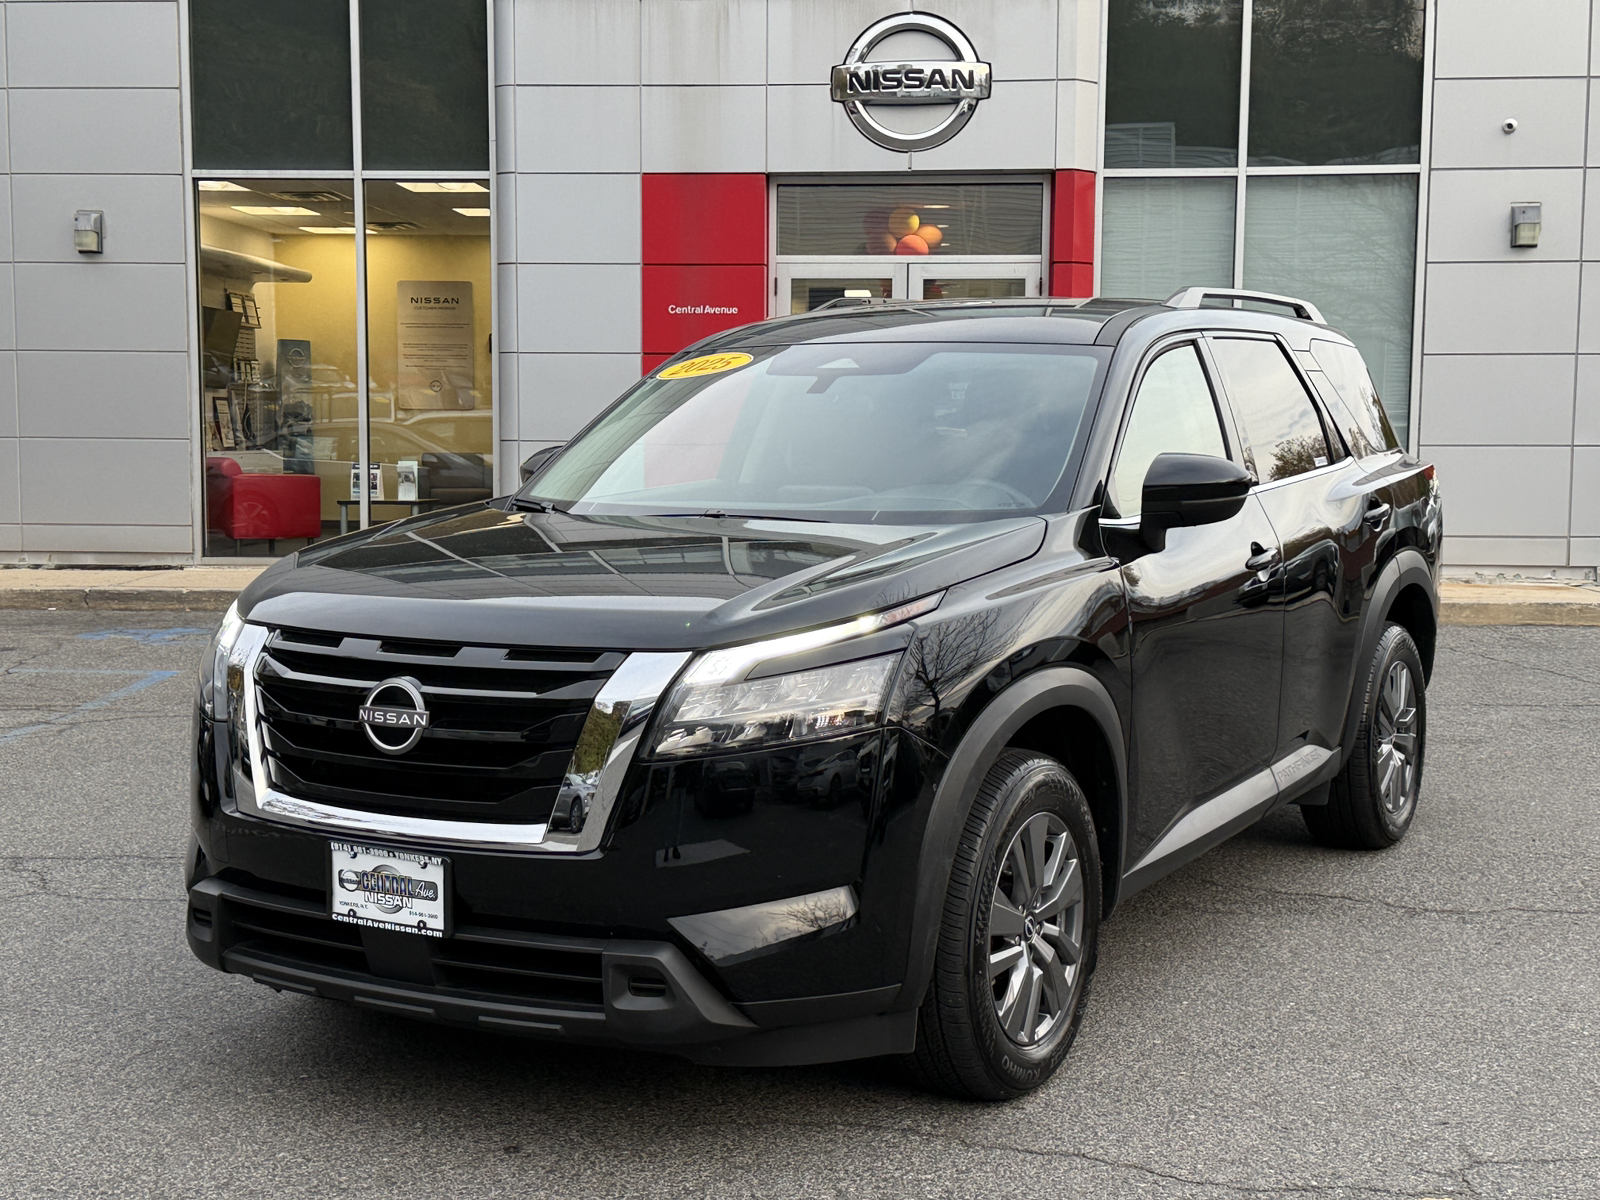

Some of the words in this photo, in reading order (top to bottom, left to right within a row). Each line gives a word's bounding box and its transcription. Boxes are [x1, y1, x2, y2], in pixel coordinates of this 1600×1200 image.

[847, 69, 975, 93] NISSAN
[668, 304, 703, 314] Central
[704, 304, 738, 314] Avenue
[667, 355, 742, 376] 2025
[359, 709, 427, 726] NISSAN
[1276, 748, 1322, 783] PATHFINDER
[361, 871, 413, 896] CENTRAL
[364, 891, 413, 909] NISSAN
[331, 913, 443, 938] CentralAveNissan.com
[1002, 1054, 1040, 1083] KUMHO
